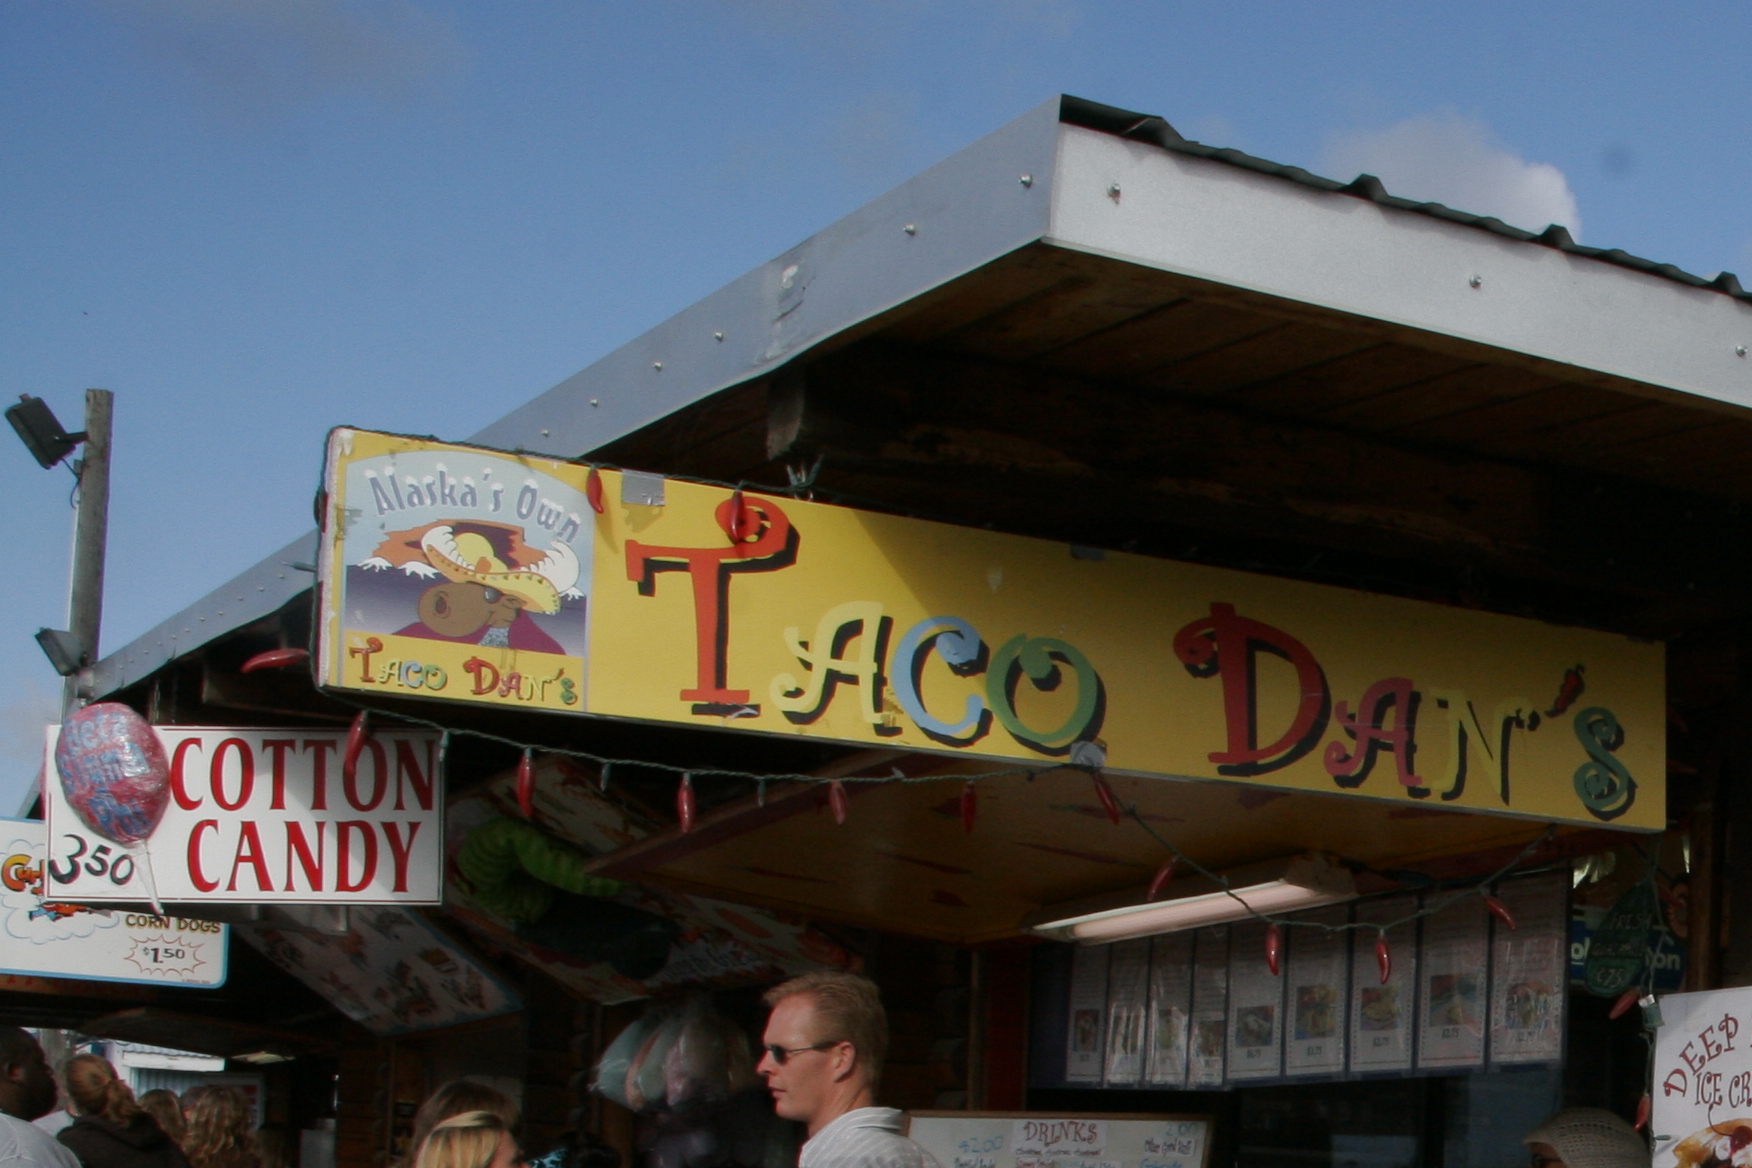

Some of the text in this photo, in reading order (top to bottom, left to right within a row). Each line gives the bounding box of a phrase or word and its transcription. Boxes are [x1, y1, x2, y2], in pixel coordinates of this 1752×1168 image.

[364, 463, 581, 554] Alaska's Own
[349, 636, 448, 692] TACO
[624, 495, 1637, 821] TACO DAN'S
[170, 736, 437, 812] COTTON
[186, 818, 422, 893] CANDY
[125, 913, 222, 934] CORN DOGS
[1662, 1013, 1739, 1097] DEEP
[1694, 1071, 1723, 1107] ICE
[1022, 1120, 1099, 1147] DRINKS
